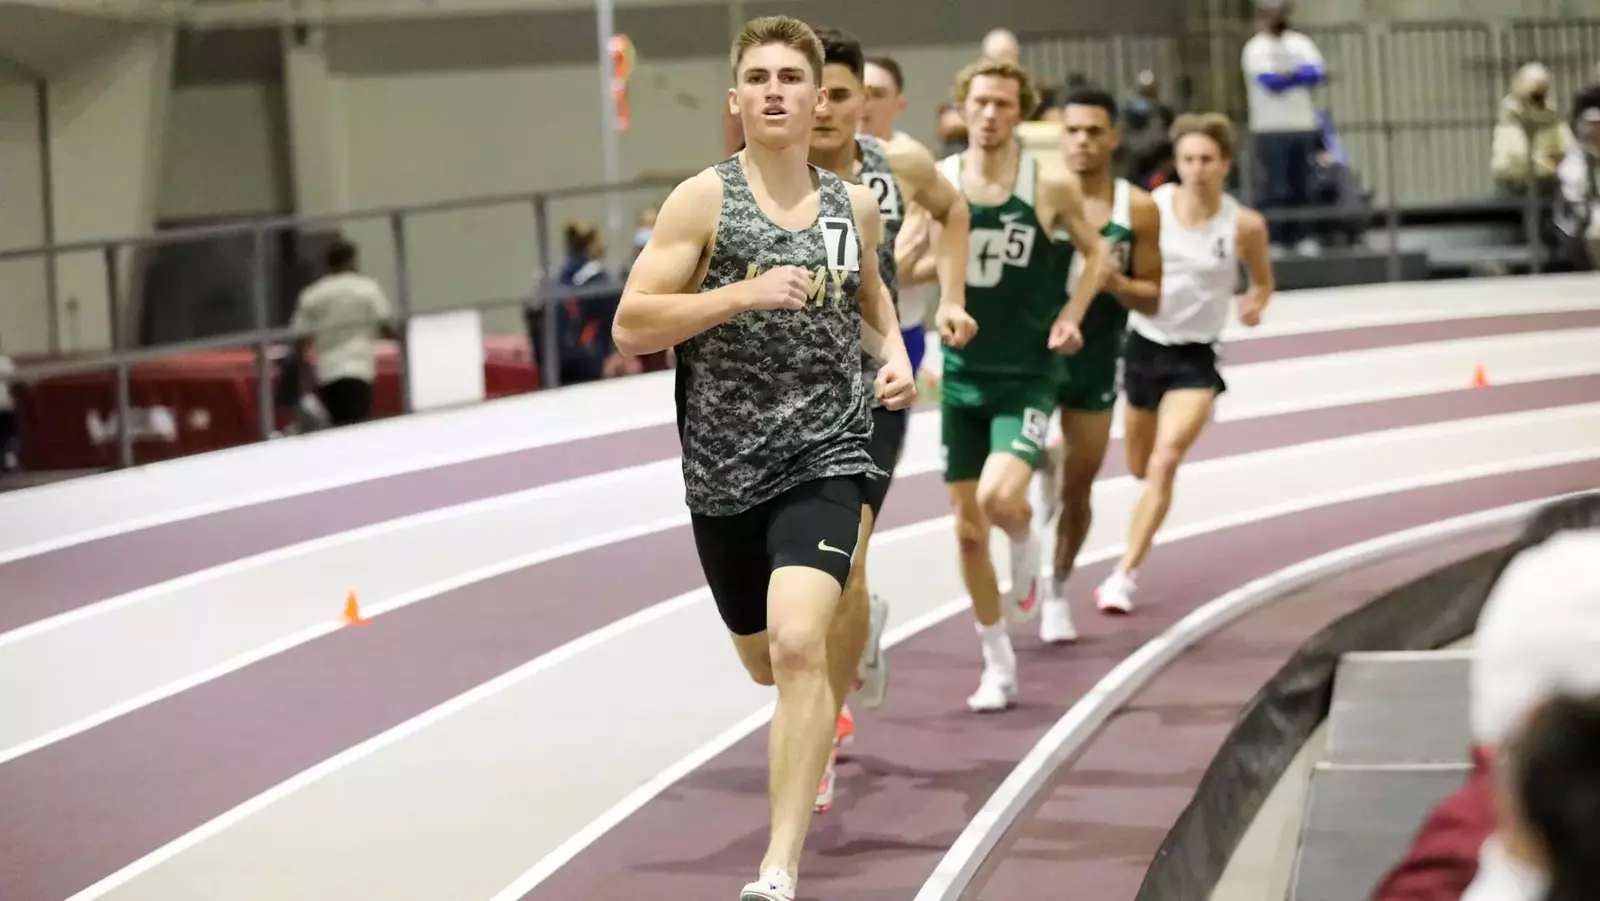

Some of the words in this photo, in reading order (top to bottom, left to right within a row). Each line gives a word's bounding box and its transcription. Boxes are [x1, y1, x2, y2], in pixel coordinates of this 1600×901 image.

[869, 177, 893, 215] 2
[825, 221, 849, 267] 7
[1004, 228, 1027, 261] 5
[1029, 413, 1046, 440] 5
